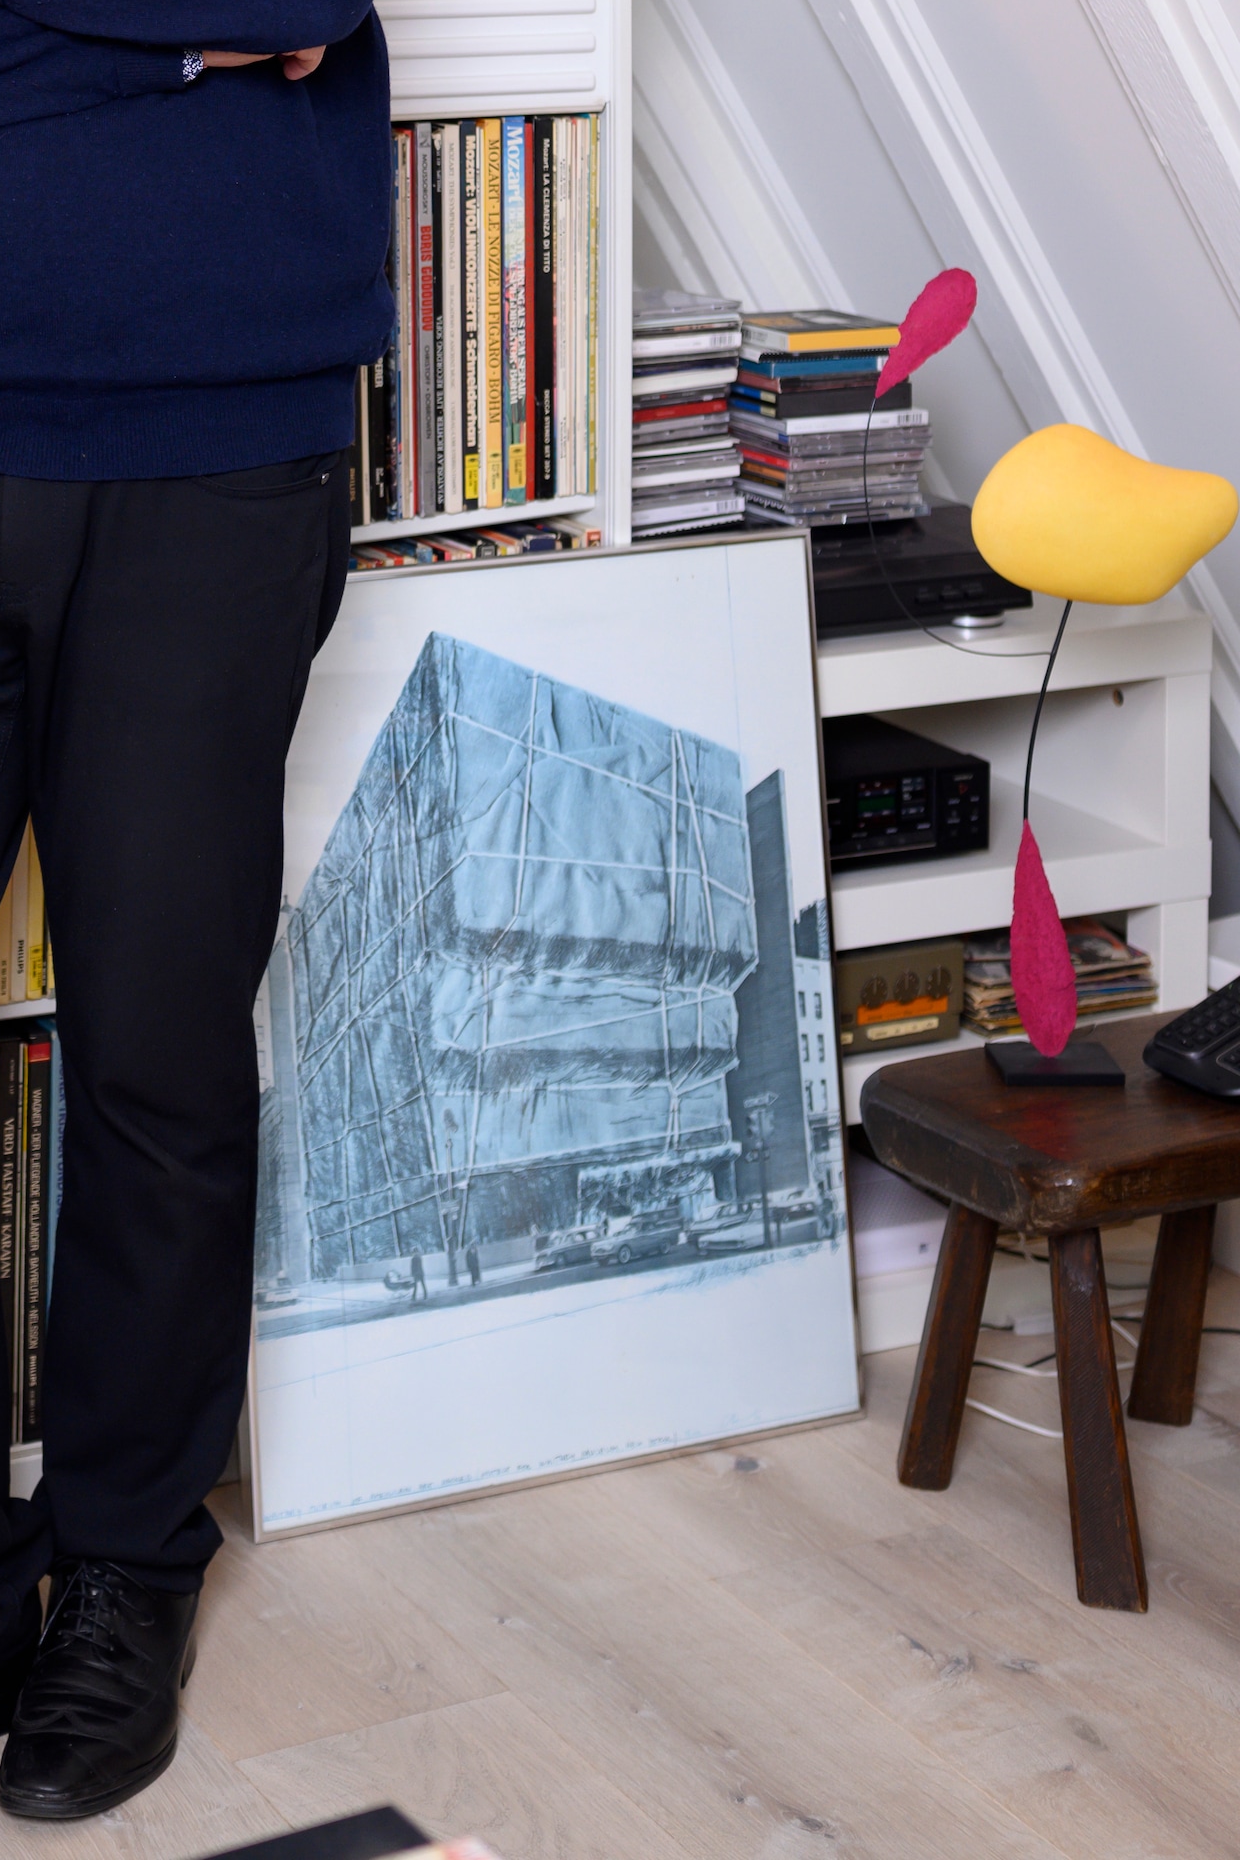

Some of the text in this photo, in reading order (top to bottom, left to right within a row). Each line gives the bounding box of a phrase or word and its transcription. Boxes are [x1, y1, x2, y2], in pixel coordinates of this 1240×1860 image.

[506, 126, 523, 203] Mozart
[543, 174, 550, 186] LA
[543, 240, 550, 250] DI
[420, 226, 433, 331] BORIS GODOUNOV
[465, 135, 477, 447] Mozart: VIOLINKONZERTE Schneiderhan
[488, 139, 501, 424] MOZART LE NOZZE DI FIGARO BÖHM
[32, 1088, 43, 1126] WAGNER
[32, 1133, 42, 1151] DER
[30, 1153, 41, 1197] FLIEGENDE
[0, 1118, 14, 1278] VERDI FALSTAFF KARAJAN
[28, 1258, 41, 1303] BAYREUTH
